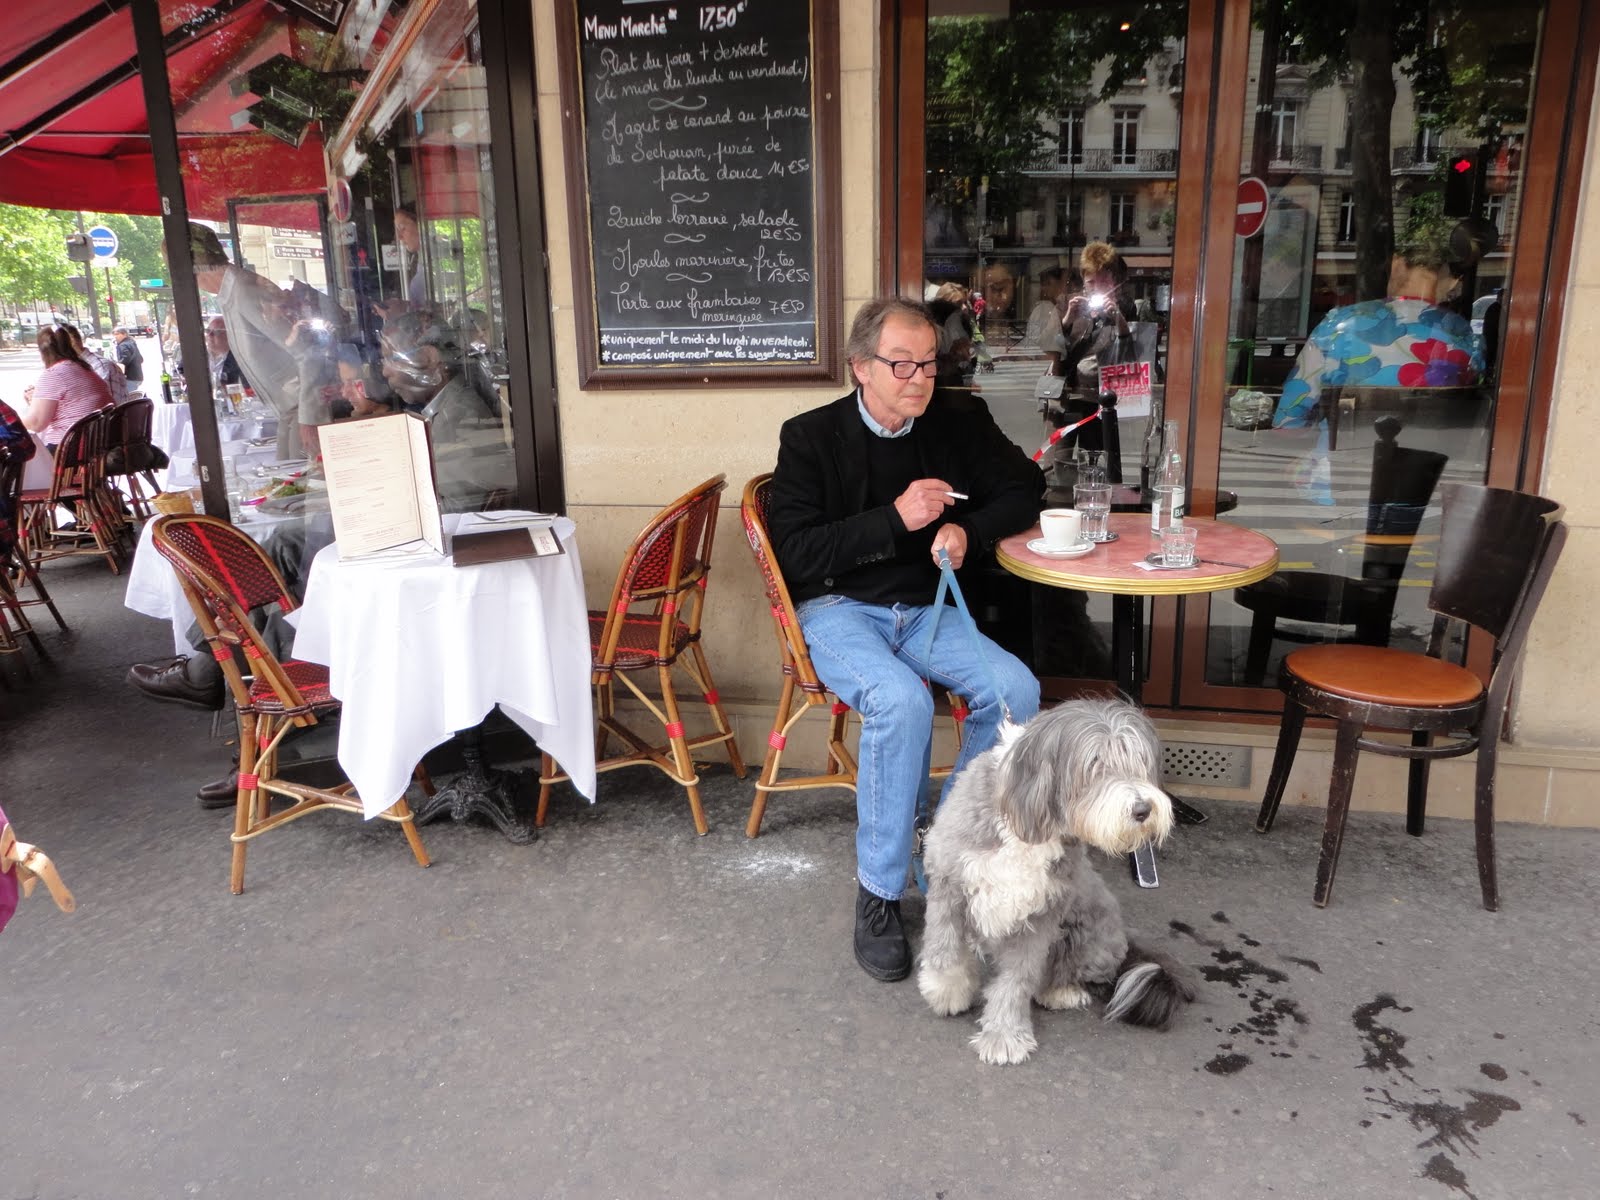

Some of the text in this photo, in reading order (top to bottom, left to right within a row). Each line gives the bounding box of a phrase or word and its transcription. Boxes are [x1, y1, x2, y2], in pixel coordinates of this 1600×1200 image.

[595, 37, 769, 81] Plat du jour + dessert
[621, 77, 660, 97] midi
[662, 78, 683, 90] du
[685, 68, 724, 86] lundi
[728, 69, 744, 81] au
[746, 55, 808, 83] vendredi)
[665, 113, 680, 131] de
[683, 106, 734, 128] canard
[737, 110, 757, 123] au
[761, 104, 810, 132] poivre
[606, 144, 625, 166] de
[712, 136, 755, 165] purée
[764, 135, 783, 152] de
[716, 163, 763, 181] douce
[606, 205, 663, 229] Quiche
[738, 208, 800, 228] salade
[612, 238, 671, 278] Moules
[753, 244, 796, 282] frites
[610, 281, 652, 314] Tarte
[655, 298, 683, 311] aux
[701, 307, 764, 333] meringuée
[670, 330, 680, 345] le
[681, 333, 706, 346] midi
[705, 332, 721, 346] du
[722, 332, 750, 347] lundi
[653, 346, 714, 362] uniquement
[714, 350, 735, 360] avec
[735, 345, 747, 360] les
